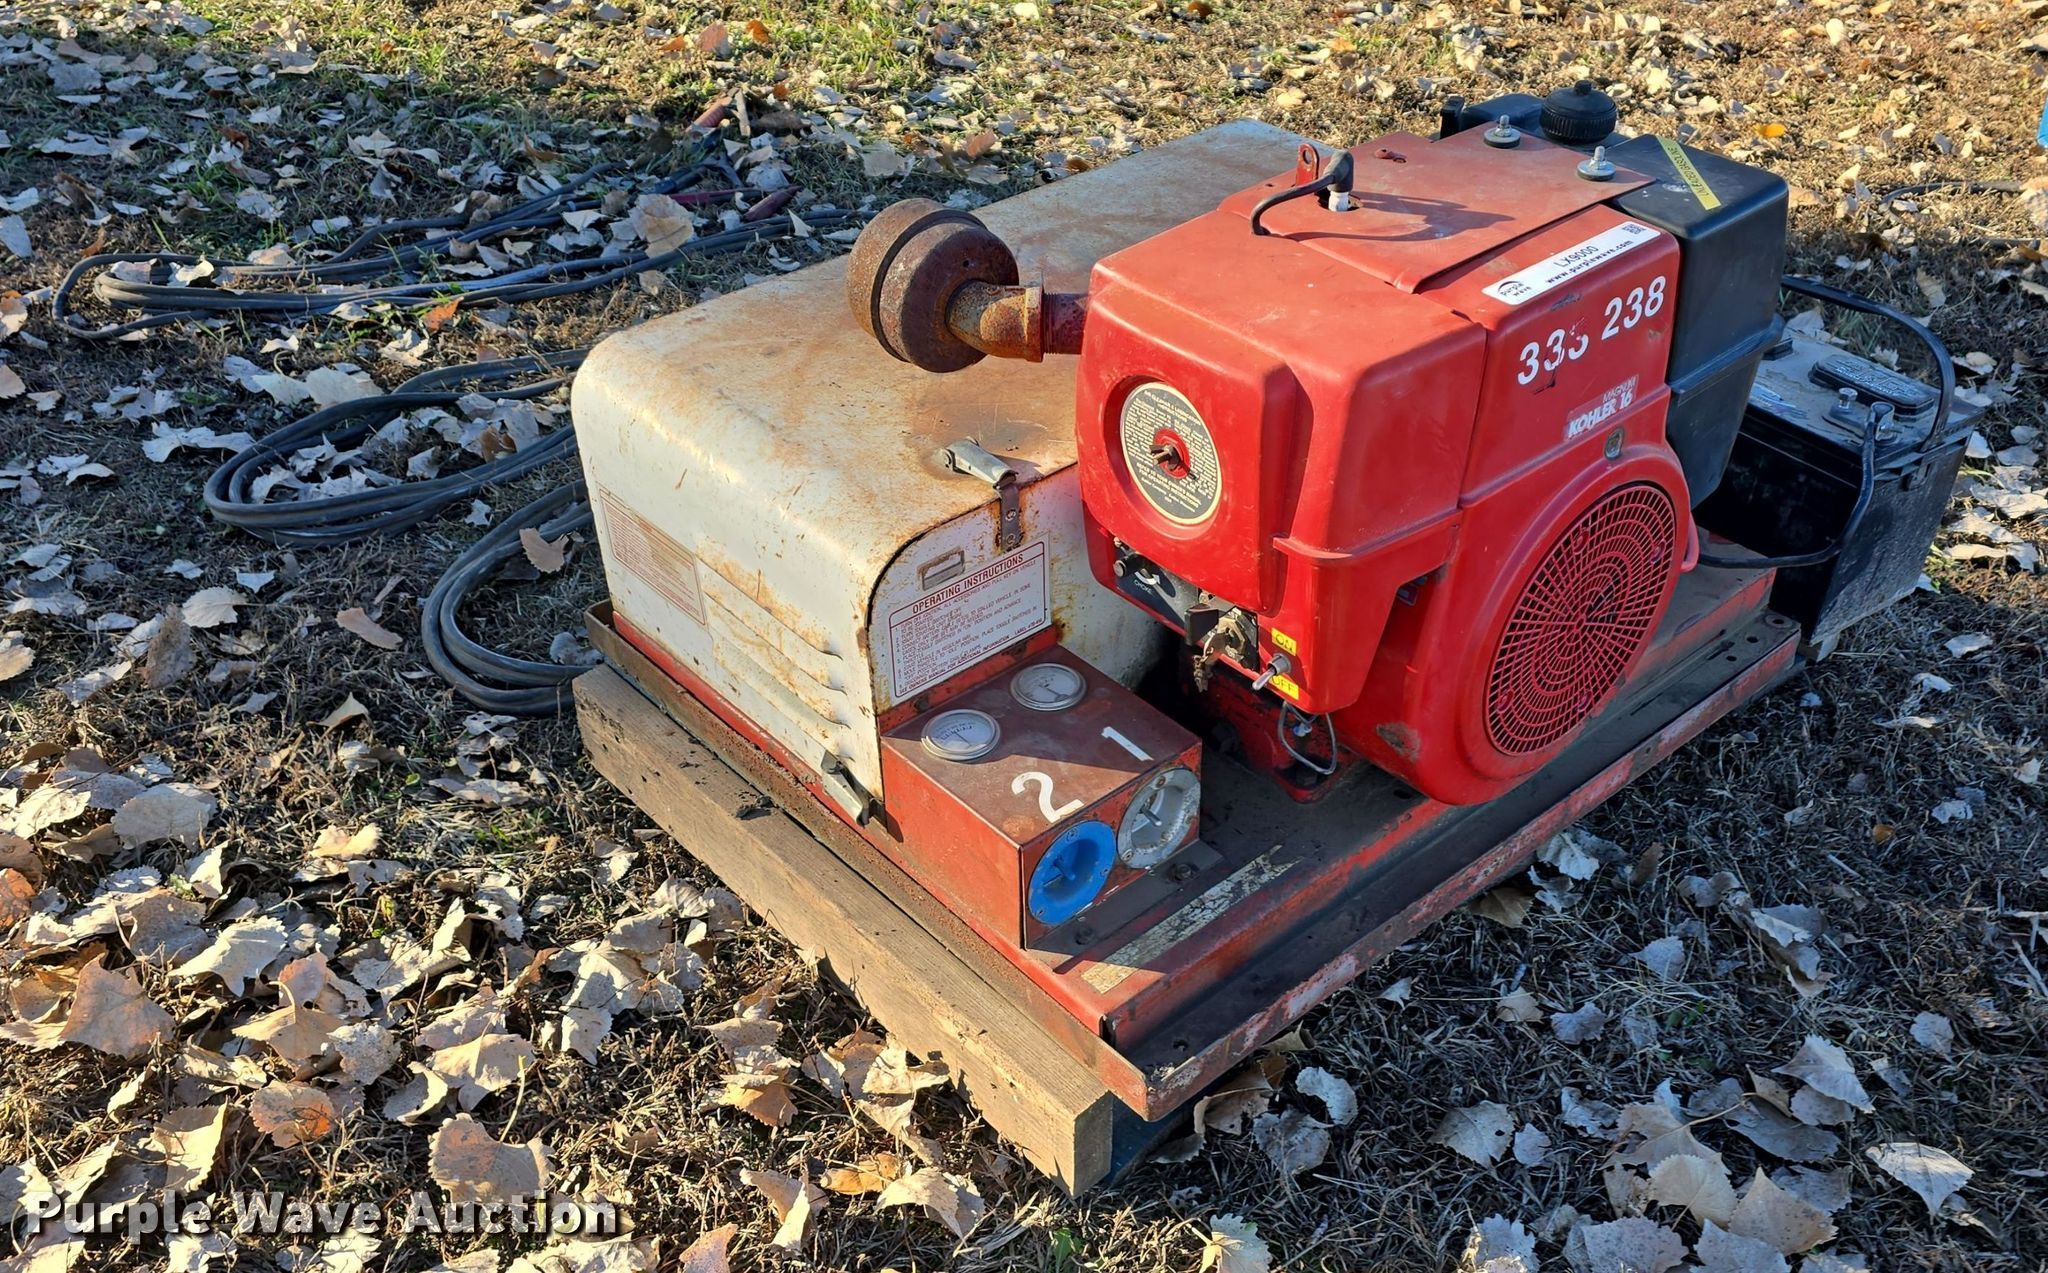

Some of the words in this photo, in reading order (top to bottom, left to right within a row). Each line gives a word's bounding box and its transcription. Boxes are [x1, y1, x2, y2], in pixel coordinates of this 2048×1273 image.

[1547, 240, 1634, 283] www.purplewave.com
[1554, 246, 1600, 267] LX9000
[1500, 281, 1524, 296] purple
[1514, 286, 1532, 296] wave
[1602, 276, 1666, 340] 238
[1603, 376, 1636, 402] MAGNUM
[1568, 399, 1617, 438] KOHLER
[1620, 388, 1633, 410] 16
[912, 585, 960, 614] OPERATING
[964, 554, 1024, 589] INSTRUCTIONS
[1275, 634, 1294, 652] ON
[1272, 675, 1295, 692] OFF
[1101, 726, 1154, 761] 1
[1012, 772, 1084, 823] 2
